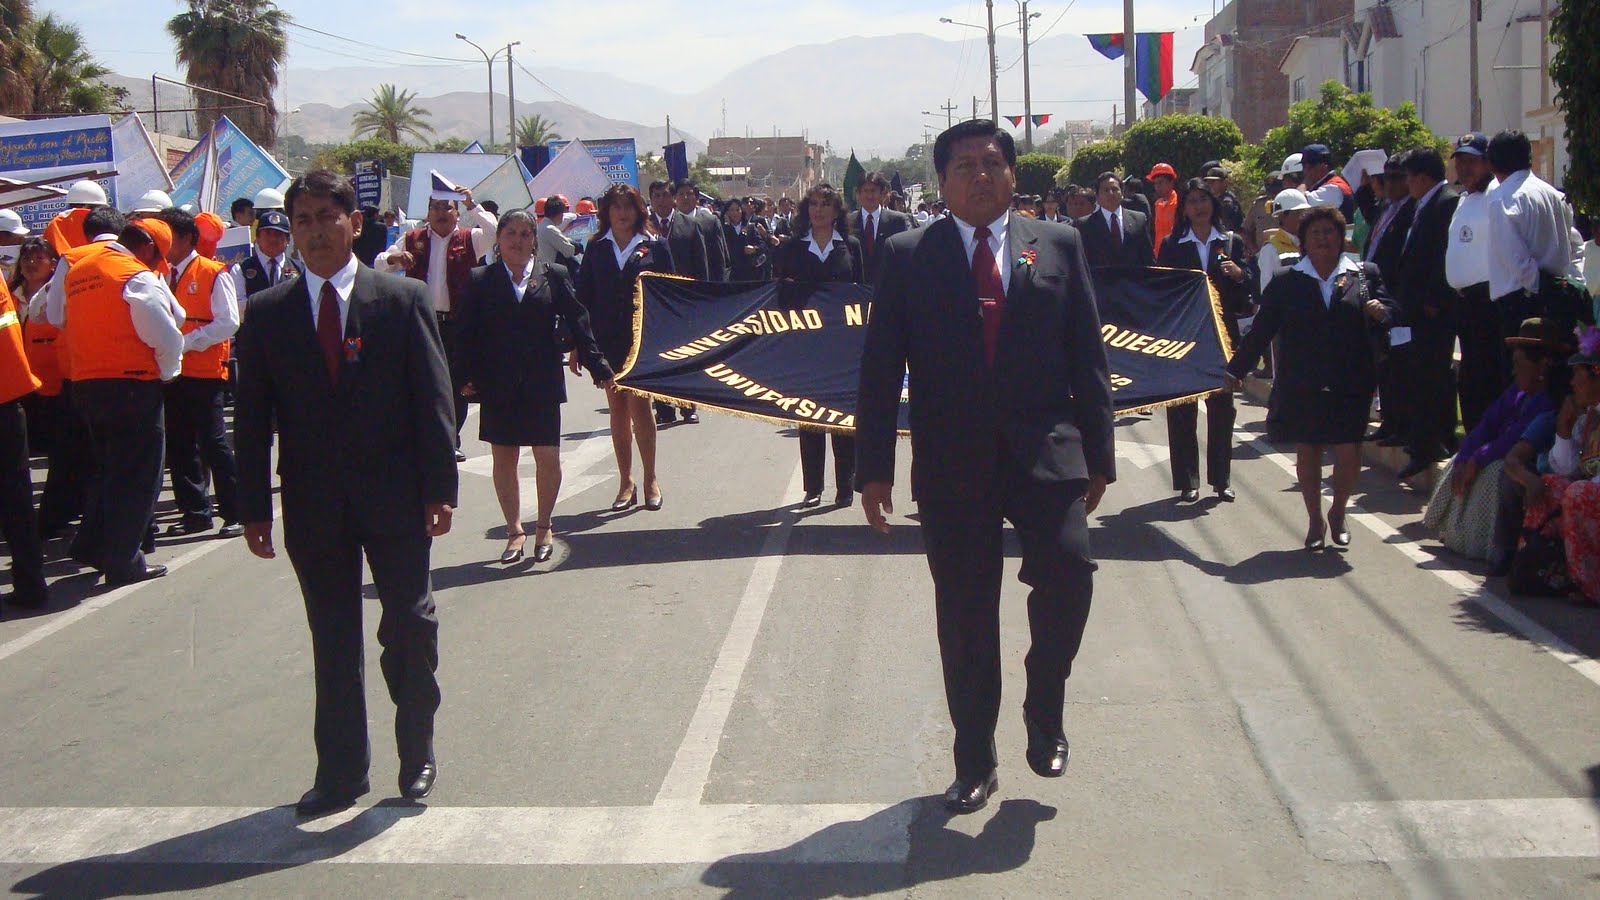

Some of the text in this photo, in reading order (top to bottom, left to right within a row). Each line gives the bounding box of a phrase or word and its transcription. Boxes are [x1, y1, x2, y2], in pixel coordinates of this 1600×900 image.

[43, 202, 66, 210] RIEGO
[659, 309, 823, 361] UNIVERSIDAD
[1101, 324, 1196, 360] QUEGUA
[704, 363, 856, 427] UNIVERSITA
